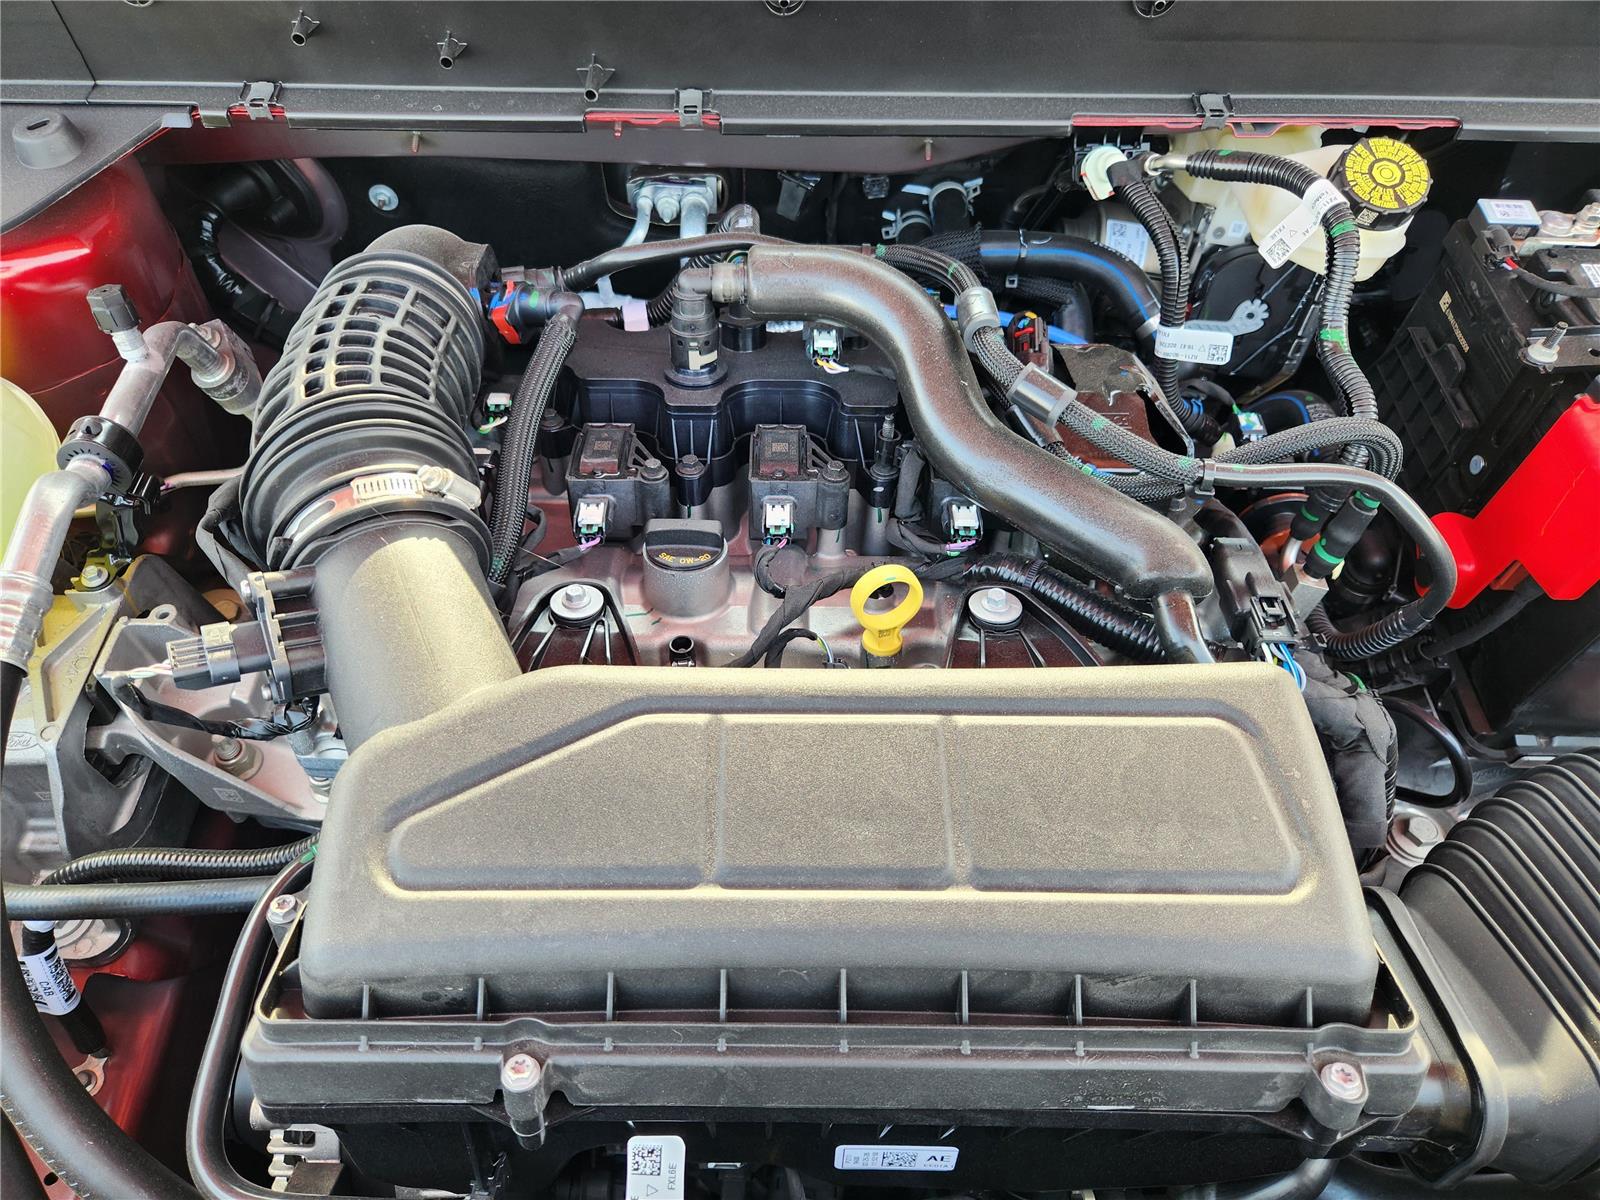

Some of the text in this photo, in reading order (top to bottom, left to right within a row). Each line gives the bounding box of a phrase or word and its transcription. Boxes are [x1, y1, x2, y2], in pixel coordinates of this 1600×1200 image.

[659, 552, 711, 564] SAE 0W-20
[39, 981, 52, 996] CAB
[667, 1162, 677, 1190] FXL6E
